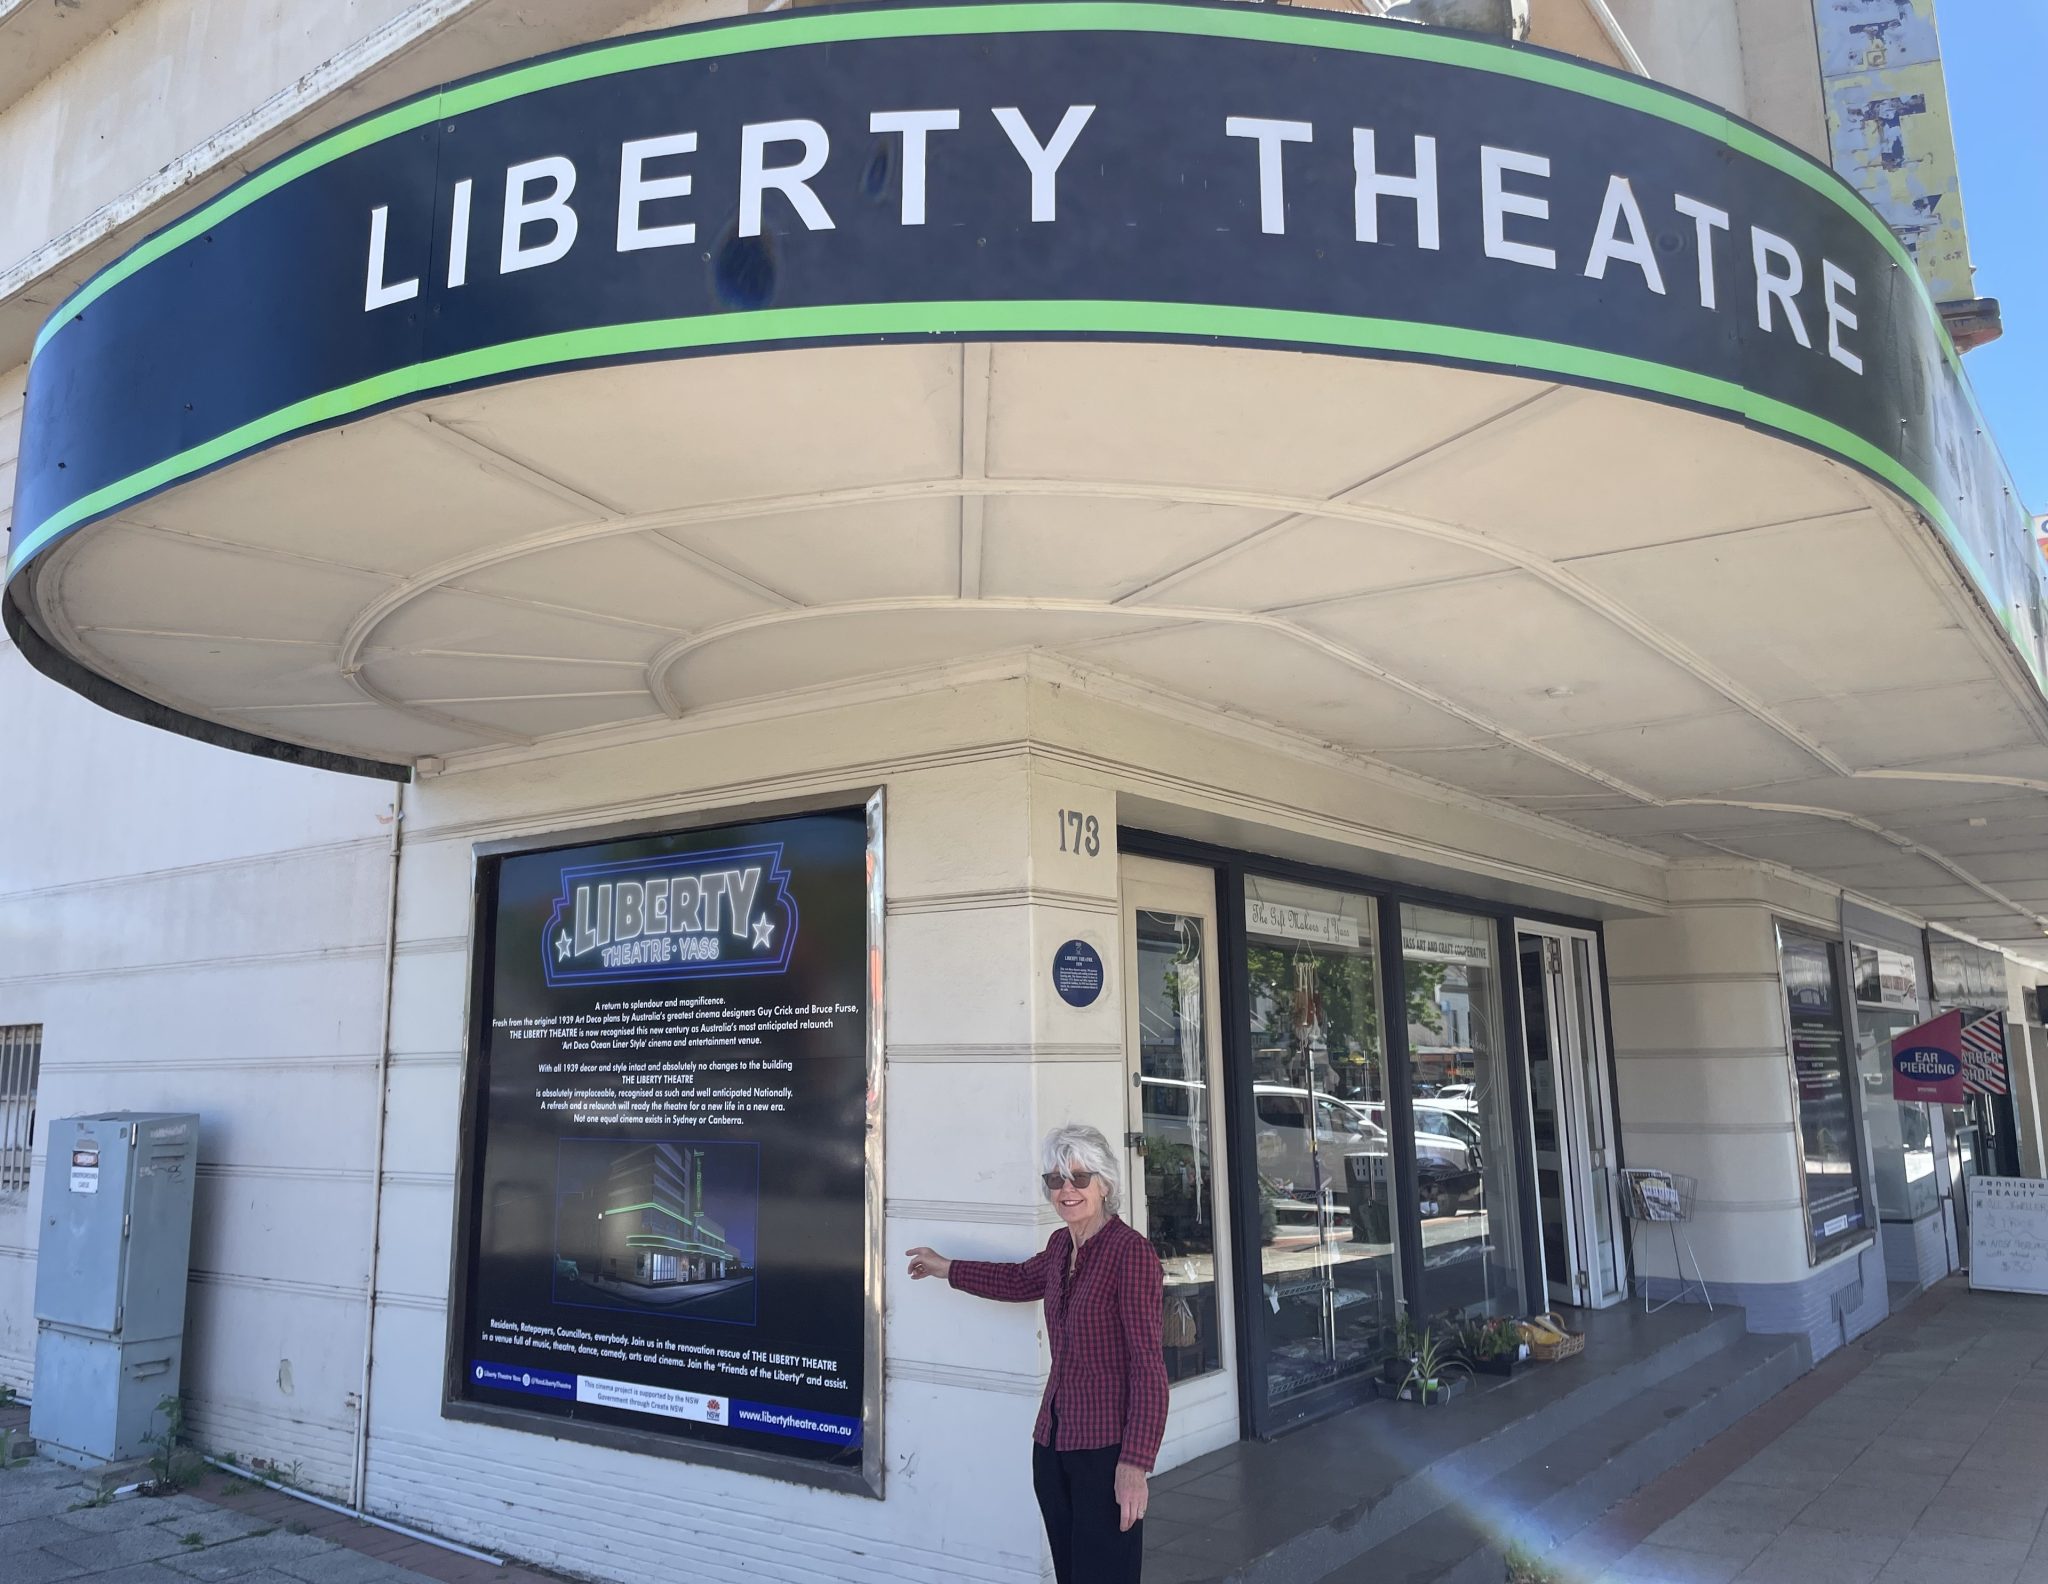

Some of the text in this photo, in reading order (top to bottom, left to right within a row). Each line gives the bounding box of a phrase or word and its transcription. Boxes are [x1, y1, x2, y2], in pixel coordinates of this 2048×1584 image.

[365, 105, 1096, 312] LIBERTY
[1225, 116, 1864, 376] THEATRE
[1058, 808, 1100, 857] 173
[574, 867, 761, 957] LIBERTY
[1252, 902, 1268, 924] The
[1270, 906, 1286, 934] Gift
[601, 936, 720, 967] THEATRE YASS
[1416, 939, 1426, 951] ART
[595, 996, 725, 1010] A return to splendour and magnificence.
[492, 1018, 508, 1027] Fresh
[509, 1018, 522, 1026] from
[534, 1016, 557, 1027] original
[559, 1015, 574, 1024] 1939
[575, 1015, 585, 1023] Art
[586, 1014, 602, 1023] Deco
[603, 1014, 620, 1023] plans
[622, 1013, 630, 1023] by
[667, 1011, 694, 1021] greatest
[695, 1010, 720, 1018] cinema
[721, 1008, 755, 1018] designers
[757, 1006, 772, 1017] Guy
[774, 1005, 793, 1015] Crick
[794, 1004, 809, 1014] and
[811, 1004, 833, 1013] Bruce
[835, 1003, 858, 1013] Furse,
[510, 1030, 522, 1038] THE
[523, 1029, 548, 1038] LIBERTY
[549, 1028, 577, 1037] THEATRE
[579, 1028, 584, 1036] is
[600, 1026, 635, 1037] recognised
[636, 1026, 648, 1034] this
[665, 1026, 690, 1034] century
[738, 1022, 756, 1030] most
[757, 1020, 798, 1031] anticipated
[800, 1019, 833, 1028] relaunch
[574, 1041, 589, 1049] Deco
[590, 1040, 611, 1048] Ocean
[612, 1039, 629, 1048] Liner
[648, 1039, 672, 1047] cinema
[673, 1037, 686, 1046] and
[688, 1036, 736, 1045] entertainment
[1915, 1052, 1938, 1063] EAR
[1961, 1051, 1999, 1065] ARBER
[538, 1064, 552, 1072] With
[553, 1063, 561, 1072] all
[564, 1063, 578, 1072] 1939
[580, 1063, 597, 1071] decor
[599, 1063, 611, 1071] and
[612, 1062, 627, 1073] style
[628, 1062, 646, 1071] intact
[648, 1061, 661, 1070] and
[662, 1061, 696, 1071] absolutely
[709, 1061, 738, 1071] changes
[740, 1061, 747, 1069] to
[749, 1060, 760, 1069] the
[762, 1059, 792, 1071] building
[1900, 1062, 1955, 1075] PIERCING
[622, 1074, 693, 1084] THE LIBERTY THEATRE
[1963, 1069, 1993, 1081] SHOP
[536, 1088, 541, 1097] is
[542, 1088, 573, 1098] absolutely
[574, 1088, 616, 1098] irreplaceable,
[618, 1088, 653, 1098] recognised
[664, 1088, 679, 1097] such
[681, 1087, 694, 1096] and
[696, 1087, 710, 1096] well
[712, 1087, 751, 1098] anticipated
[753, 1087, 793, 1098] Nationally.
[574, 1113, 585, 1122] Not
[587, 1114, 598, 1122] one
[600, 1114, 618, 1124] equal
[620, 1114, 643, 1123] cinema
[645, 1114, 662, 1123] exists
[664, 1114, 671, 1123] in
[673, 1114, 697, 1125] Sydney
[708, 1115, 743, 1124] Canberra.
[1988, 1189, 2035, 1197] BEAUTY
[491, 1319, 518, 1331] Residents,
[521, 1322, 555, 1335] Ratepayers,
[557, 1327, 592, 1340] Councillors,
[595, 1334, 629, 1345] everybody.
[631, 1336, 644, 1346] Join
[656, 1338, 663, 1348] in
[665, 1340, 675, 1350] the
[678, 1344, 714, 1355] renovation
[717, 1349, 740, 1358] rescue
[742, 1350, 749, 1359] of
[752, 1351, 766, 1362] THE
[769, 1353, 799, 1365] LIBERTY
[802, 1357, 836, 1371] THEATRE
[482, 1331, 488, 1340] in
[495, 1335, 512, 1343] venue
[514, 1335, 524, 1344] full
[524, 1337, 531, 1345] of
[532, 1339, 551, 1349] music,
[553, 1341, 576, 1352] theatre,
[578, 1344, 599, 1356] dance,
[600, 1349, 627, 1360] comedy,
[629, 1352, 642, 1361] arts
[643, 1353, 657, 1362] and
[658, 1355, 685, 1366] cinema.
[687, 1358, 702, 1369] Join
[703, 1360, 715, 1371] the
[749, 1366, 757, 1376] of
[759, 1368, 772, 1378] the
[806, 1375, 822, 1385] and
[824, 1378, 848, 1389] assist.
[584, 1380, 594, 1388] This
[595, 1383, 613, 1391] cinema
[614, 1385, 633, 1395] project
[639, 1390, 666, 1400] supported
[675, 1395, 684, 1403] the
[685, 1396, 699, 1405] NSW
[670, 1404, 683, 1413] NSW
[707, 1411, 720, 1419] NSW
[739, 1409, 852, 1436] www.libertytheatre.com.au
